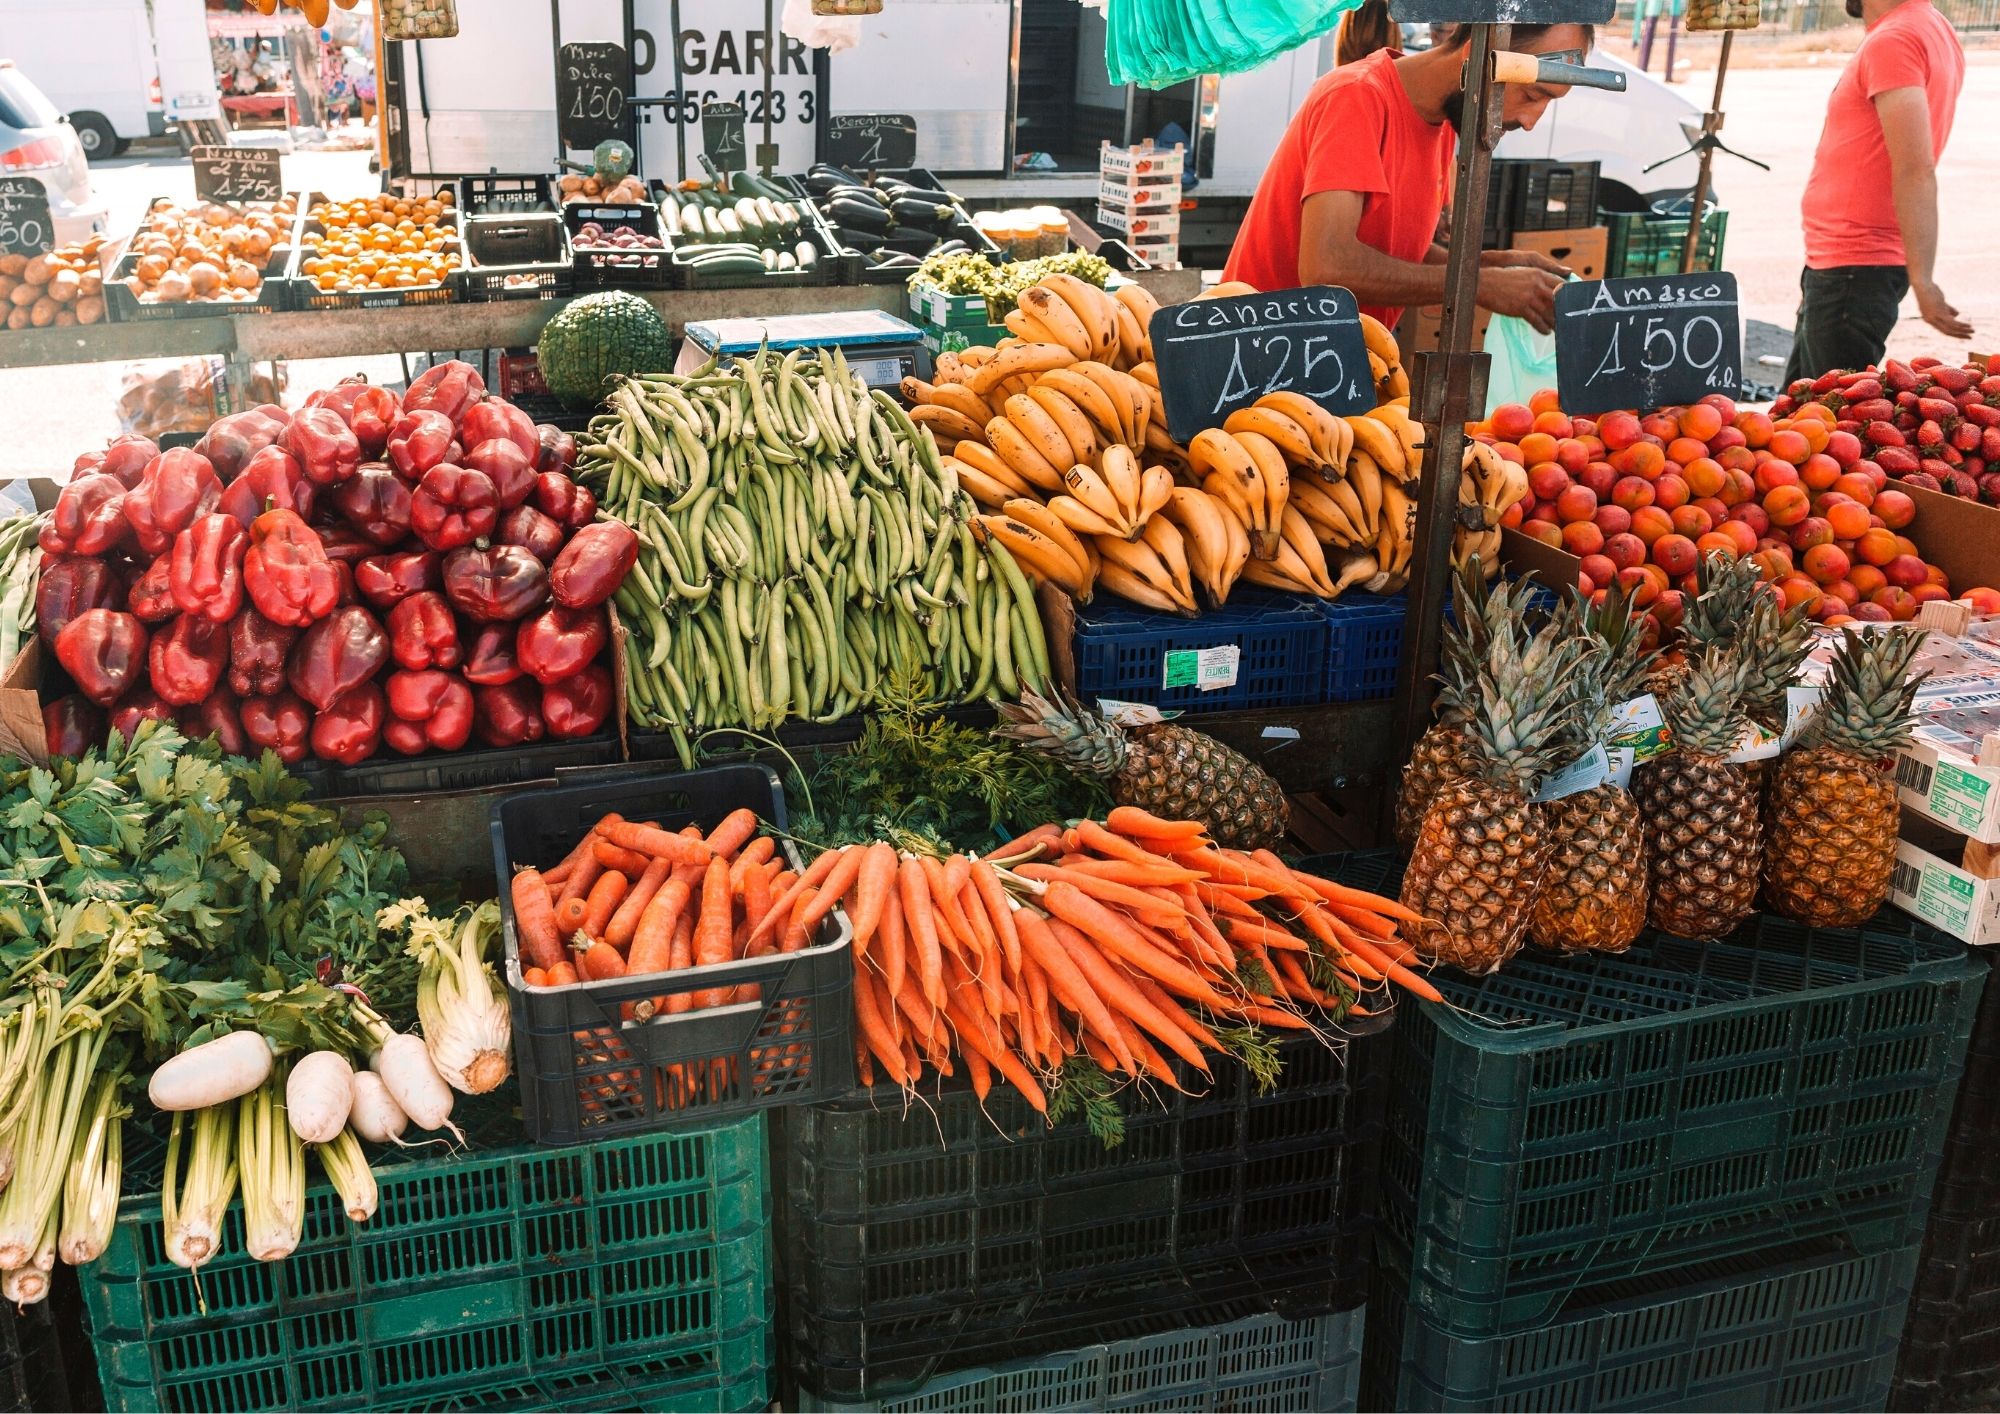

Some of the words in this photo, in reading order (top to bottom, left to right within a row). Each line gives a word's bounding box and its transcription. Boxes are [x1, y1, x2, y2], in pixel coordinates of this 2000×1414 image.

[680, 29, 817, 75] GARR
[798, 90, 815, 124] 3
[859, 136, 888, 163] 1
[1176, 297, 1338, 327] Canario
[1587, 280, 1722, 317] Amasco
